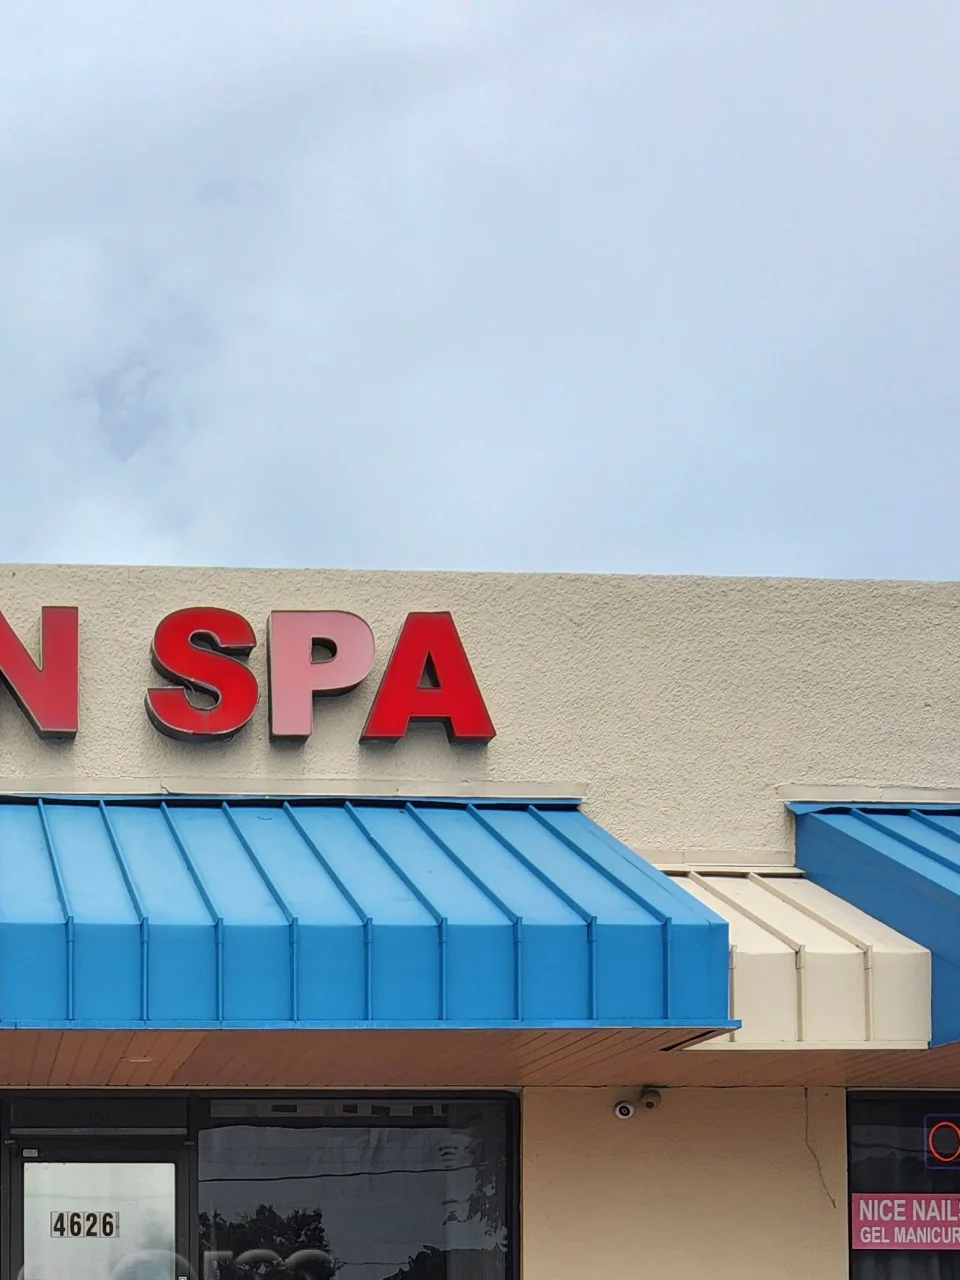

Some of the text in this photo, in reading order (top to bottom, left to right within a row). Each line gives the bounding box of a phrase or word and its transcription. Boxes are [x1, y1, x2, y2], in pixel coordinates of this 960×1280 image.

[144, 606, 497, 745] SPA
[859, 1199, 960, 1221] NICE NAIL
[52, 1212, 115, 1237] 4626
[860, 1226, 890, 1243] GEL
